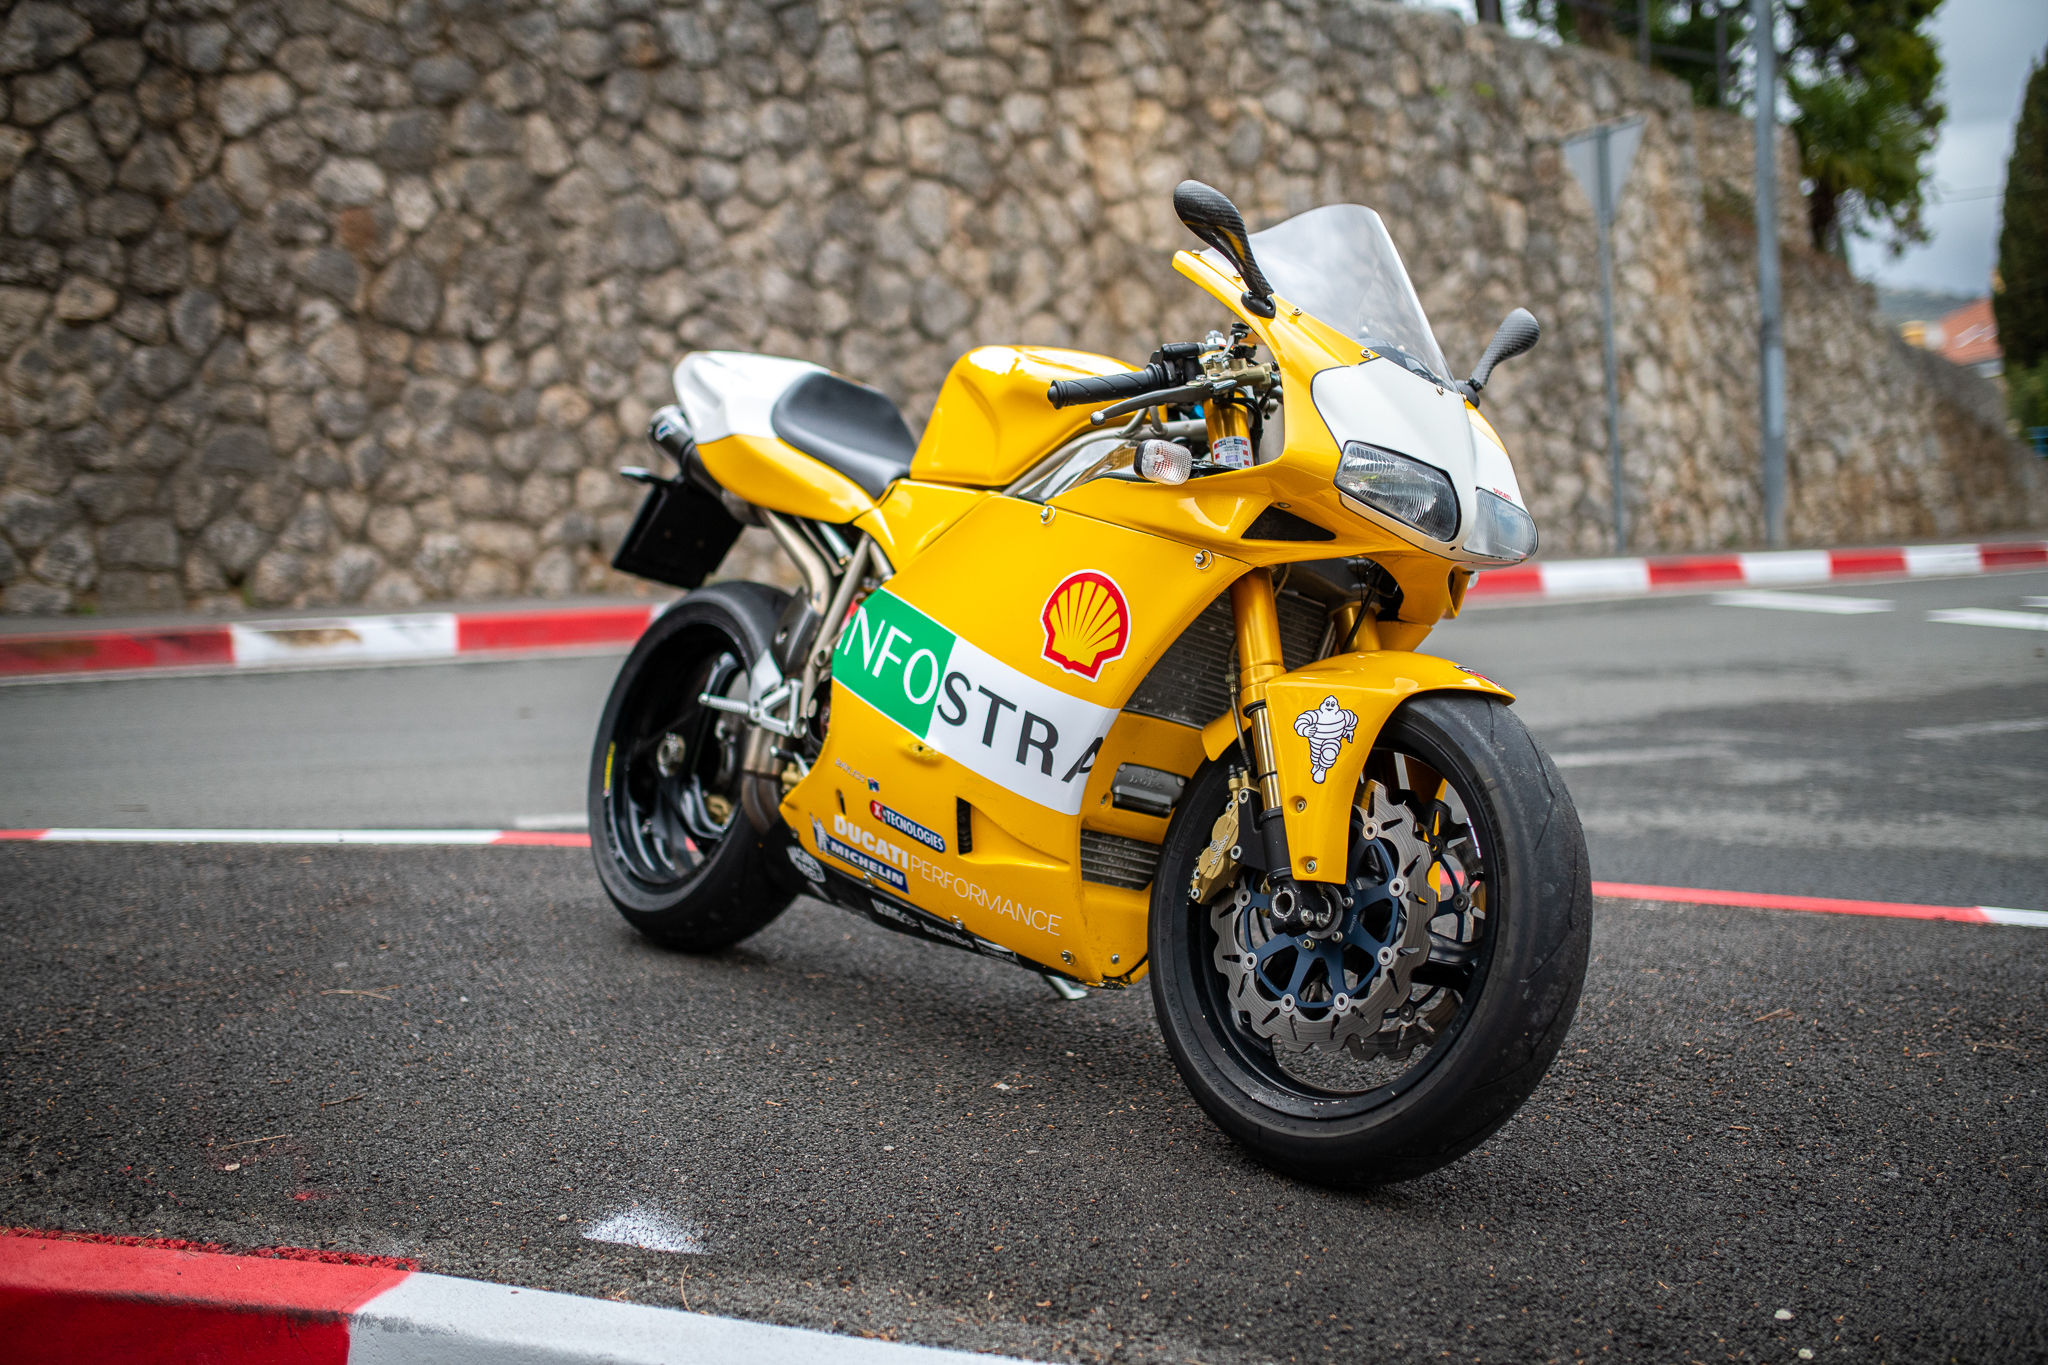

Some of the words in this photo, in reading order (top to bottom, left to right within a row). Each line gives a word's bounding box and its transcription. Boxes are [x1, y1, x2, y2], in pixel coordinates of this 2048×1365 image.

[886, 810, 944, 851] TECNOLOGIES
[1209, 834, 1229, 866] brembo
[831, 841, 904, 886] MICHELIN
[833, 813, 909, 870] DUCATI
[910, 854, 1063, 936] PERFORMANCE
[920, 919, 975, 949] brembo
